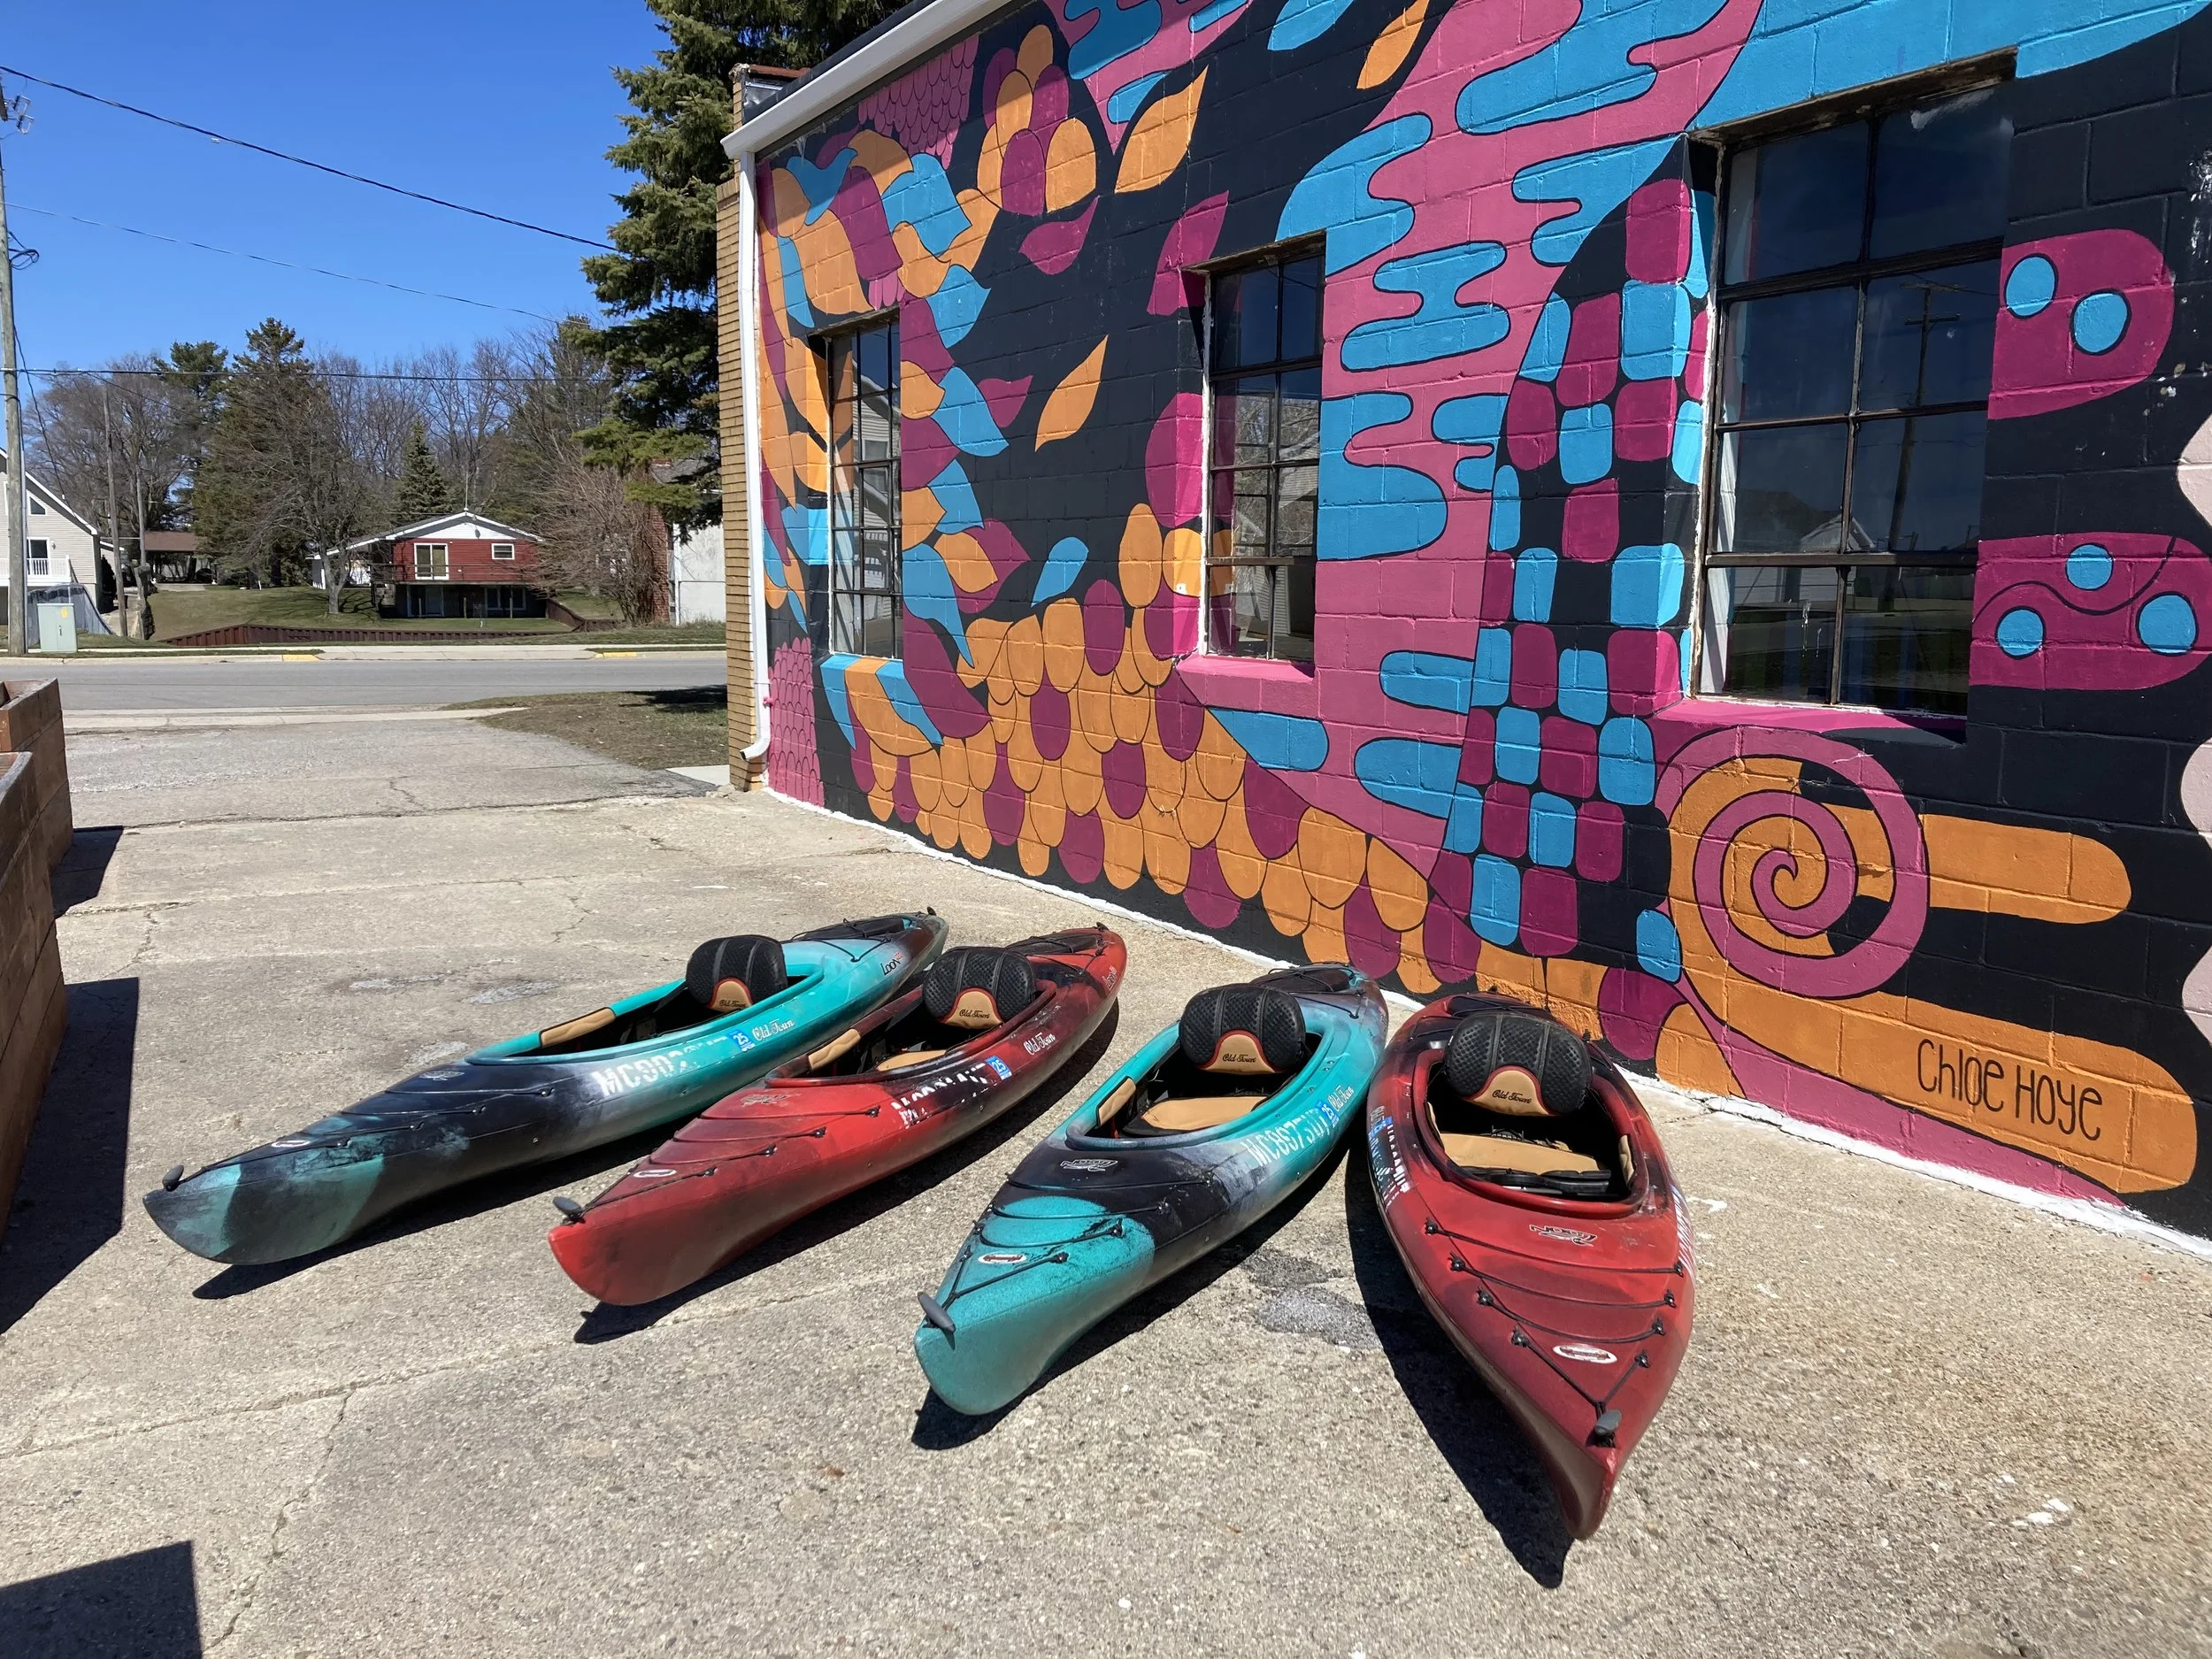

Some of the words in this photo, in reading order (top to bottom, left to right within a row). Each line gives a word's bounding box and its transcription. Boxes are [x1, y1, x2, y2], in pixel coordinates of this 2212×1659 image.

[752, 1023, 772, 1041] Old
[733, 1033, 749, 1045] 25
[1222, 1053, 1237, 1062] Old
[991, 1059, 1007, 1072] 25
[1492, 1089, 1509, 1099] Old
